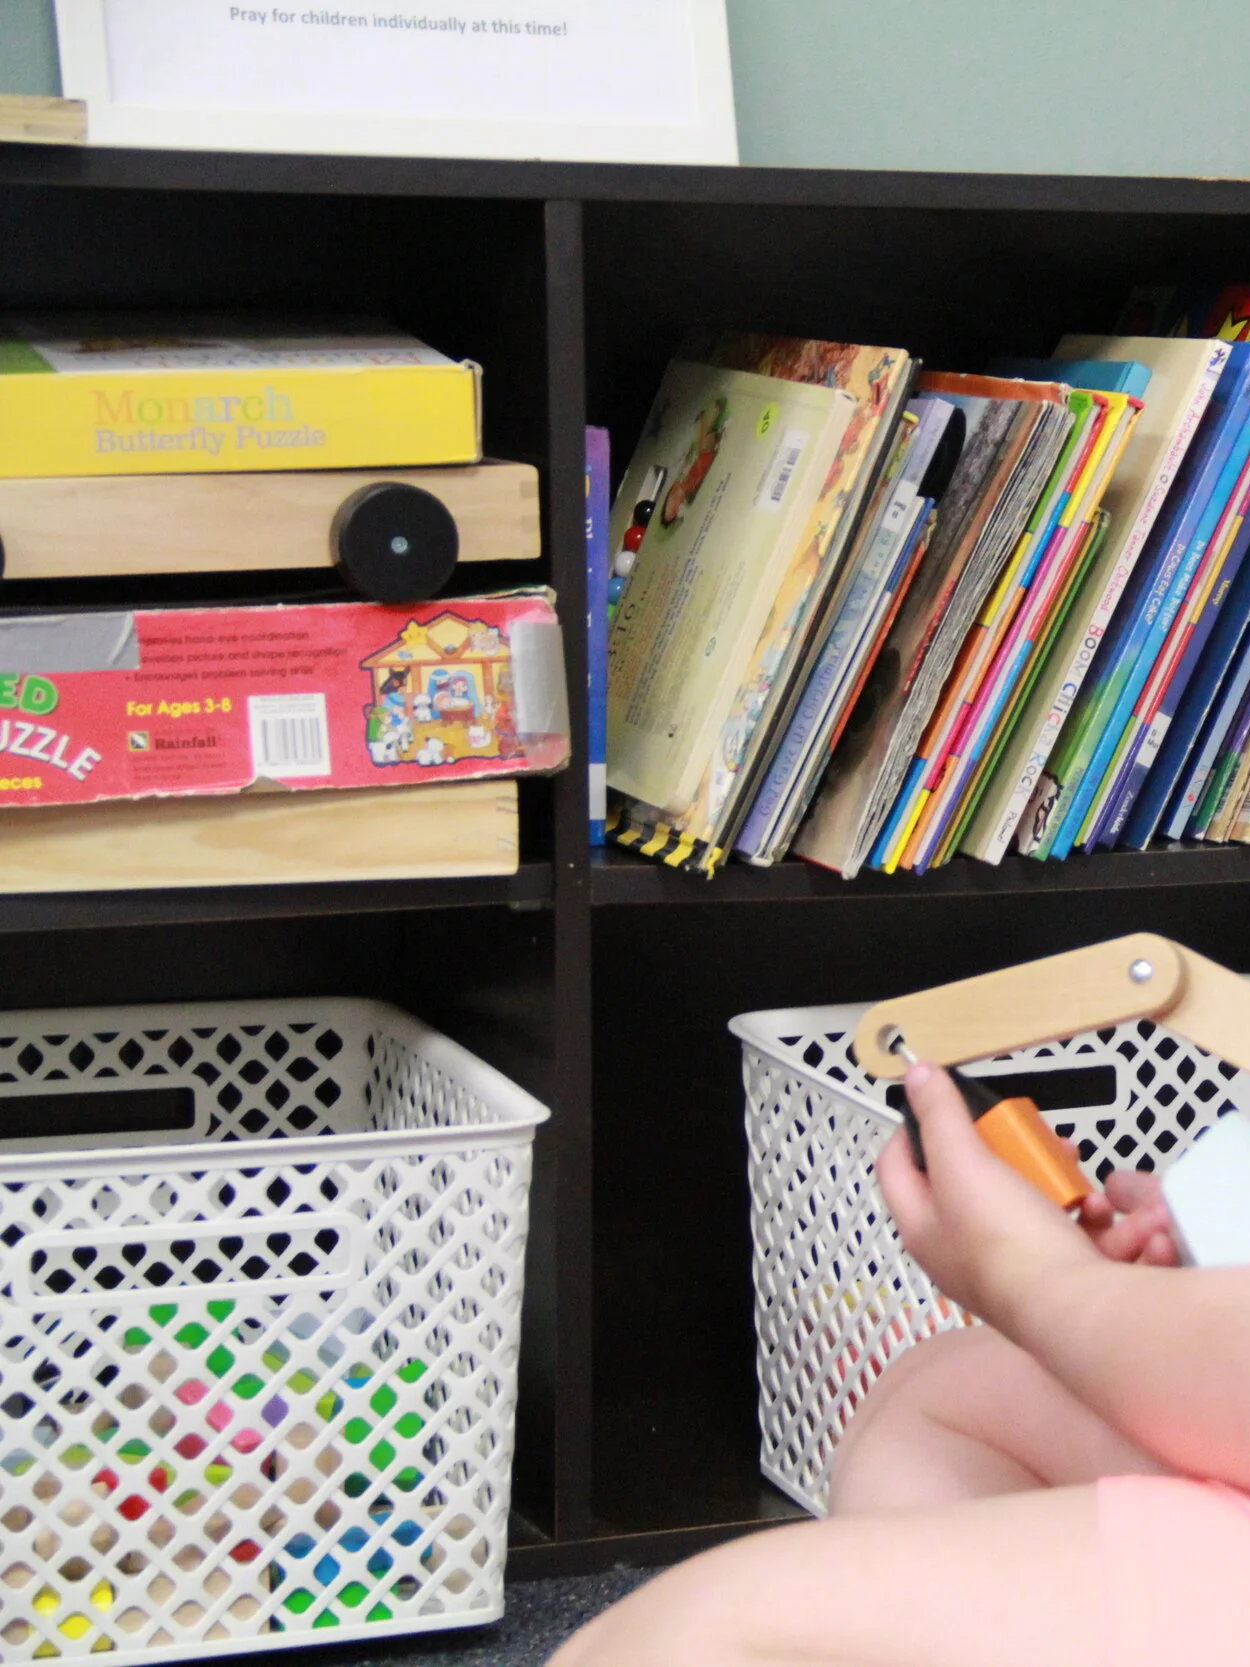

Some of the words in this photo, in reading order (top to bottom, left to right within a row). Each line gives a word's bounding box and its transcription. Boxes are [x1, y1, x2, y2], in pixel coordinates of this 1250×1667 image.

[230, 6, 267, 24] Pray
[272, 8, 296, 24] for
[301, 11, 368, 28] children
[373, 14, 467, 34] individually
[471, 20, 488, 33] at
[491, 19, 521, 35] this
[525, 21, 569, 37] time!
[91, 386, 294, 426] Monarch
[1195, 383, 1210, 408] John
[95, 426, 227, 455] Butterfly
[236, 424, 327, 450] Puzzle
[1165, 409, 1198, 473] Archambault
[1101, 564, 1128, 614] Chitwood
[141, 654, 184, 664] evelops
[127, 701, 152, 716] For
[157, 699, 201, 718] Ages
[205, 697, 232, 713] 3-8
[155, 735, 217, 750] Rainfall
